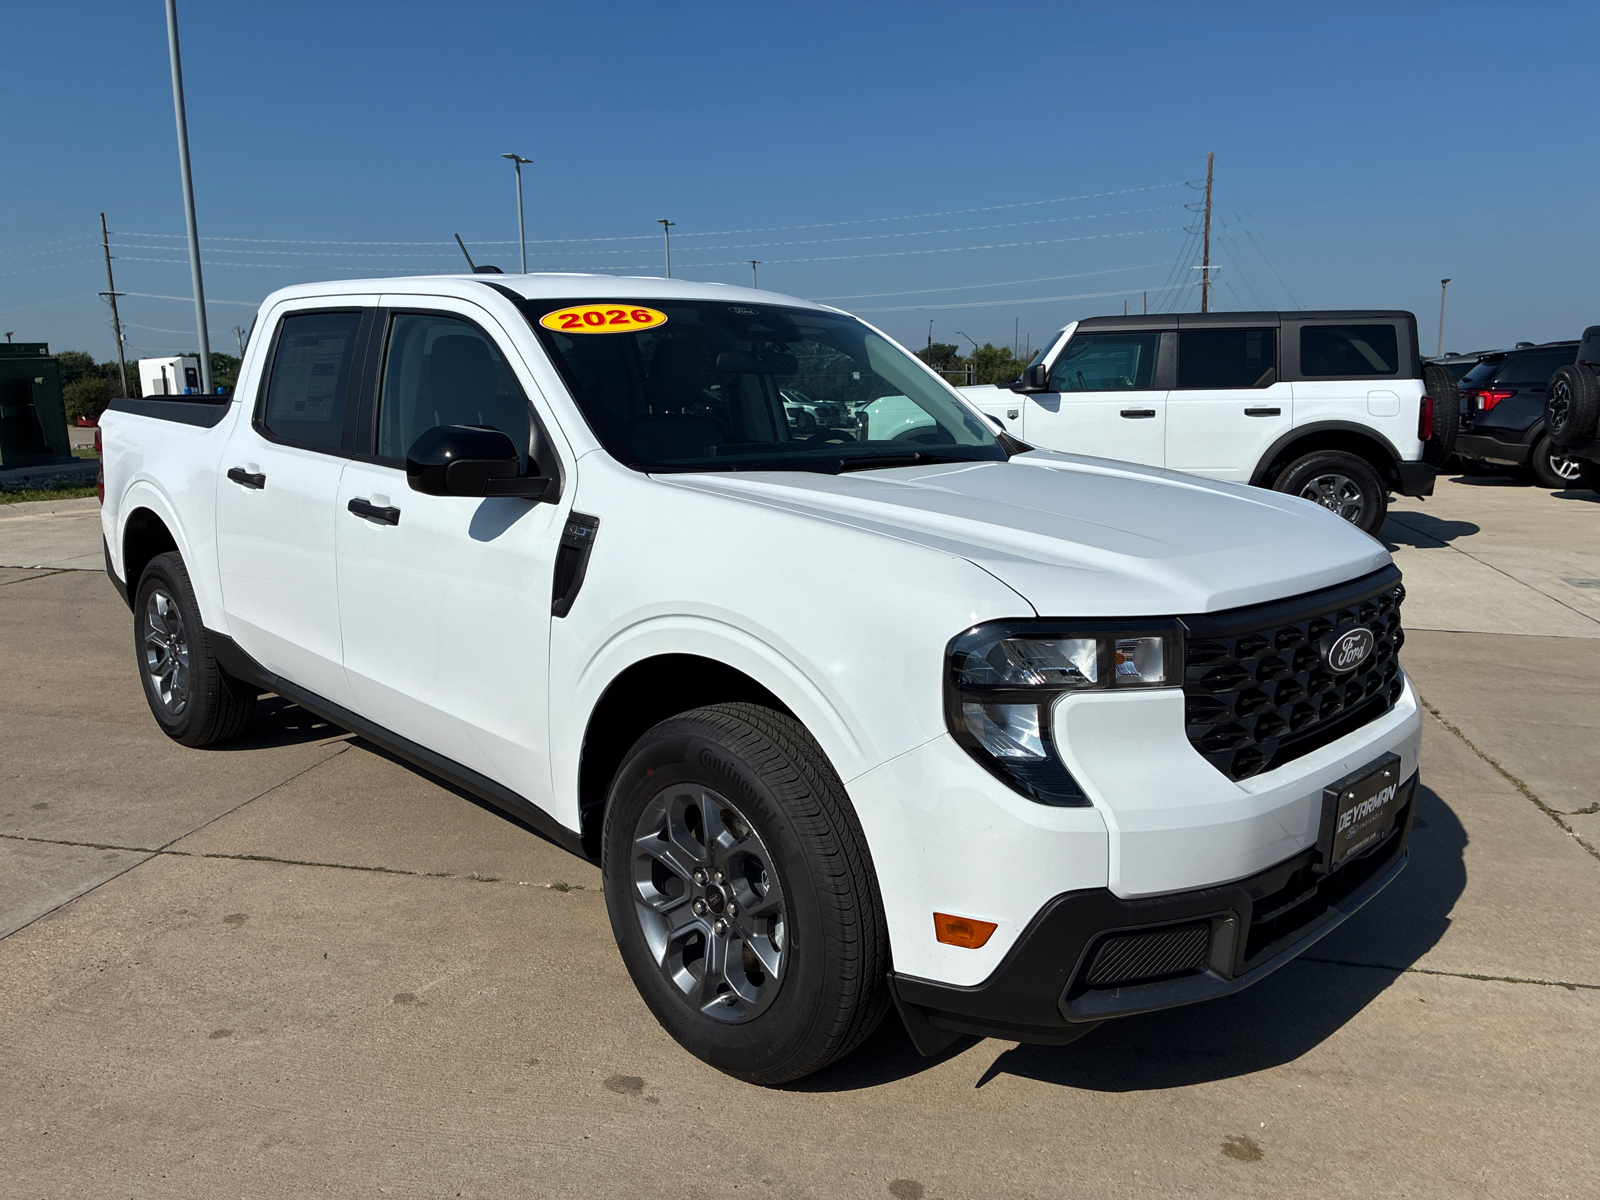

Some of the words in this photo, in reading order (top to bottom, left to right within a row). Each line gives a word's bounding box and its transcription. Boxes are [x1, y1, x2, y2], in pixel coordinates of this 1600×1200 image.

[558, 309, 653, 329] 2026
[1338, 634, 1367, 667] Ford
[699, 749, 778, 827] Continental
[1337, 784, 1397, 833] DEYARMAN
